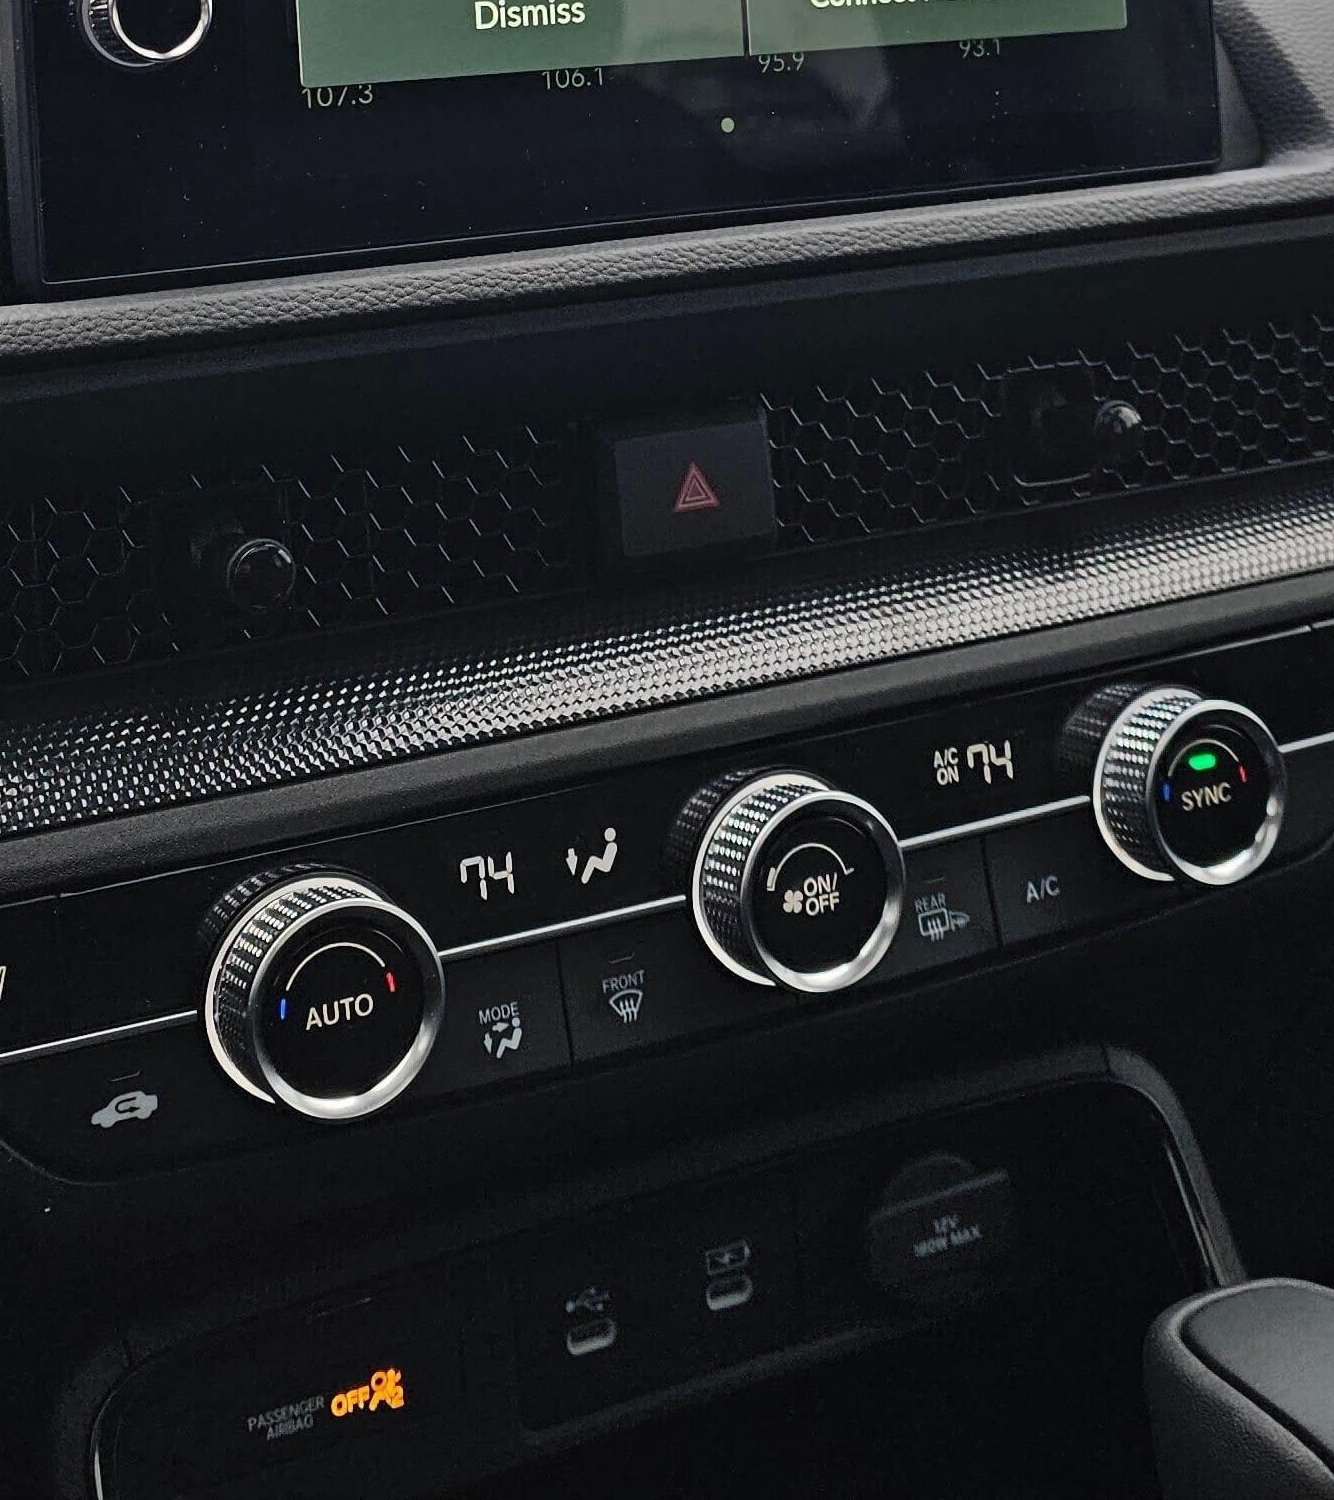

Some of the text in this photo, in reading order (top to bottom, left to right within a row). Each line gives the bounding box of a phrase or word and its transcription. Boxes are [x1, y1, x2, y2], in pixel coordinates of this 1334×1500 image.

[958, 38, 1001, 59] 93.1
[757, 51, 806, 74] 95.9
[541, 66, 605, 91] 106.1
[933, 747, 959, 769] A/C
[966, 739, 1013, 785] 74
[936, 765, 959, 786] ON
[1180, 781, 1233, 812] SYNC
[458, 850, 515, 901] 74
[803, 871, 838, 898] ON/
[1024, 875, 1061, 904] A/C
[804, 891, 840, 917] OFF
[915, 892, 947, 914] REAR
[602, 969, 646, 994] FRONT
[304, 991, 375, 1032] AUTO
[477, 1000, 520, 1025] MODE
[247, 1395, 325, 1433] PASSENGER
[330, 1385, 370, 1418] OFF
[266, 1414, 314, 1441] AIRBAG
